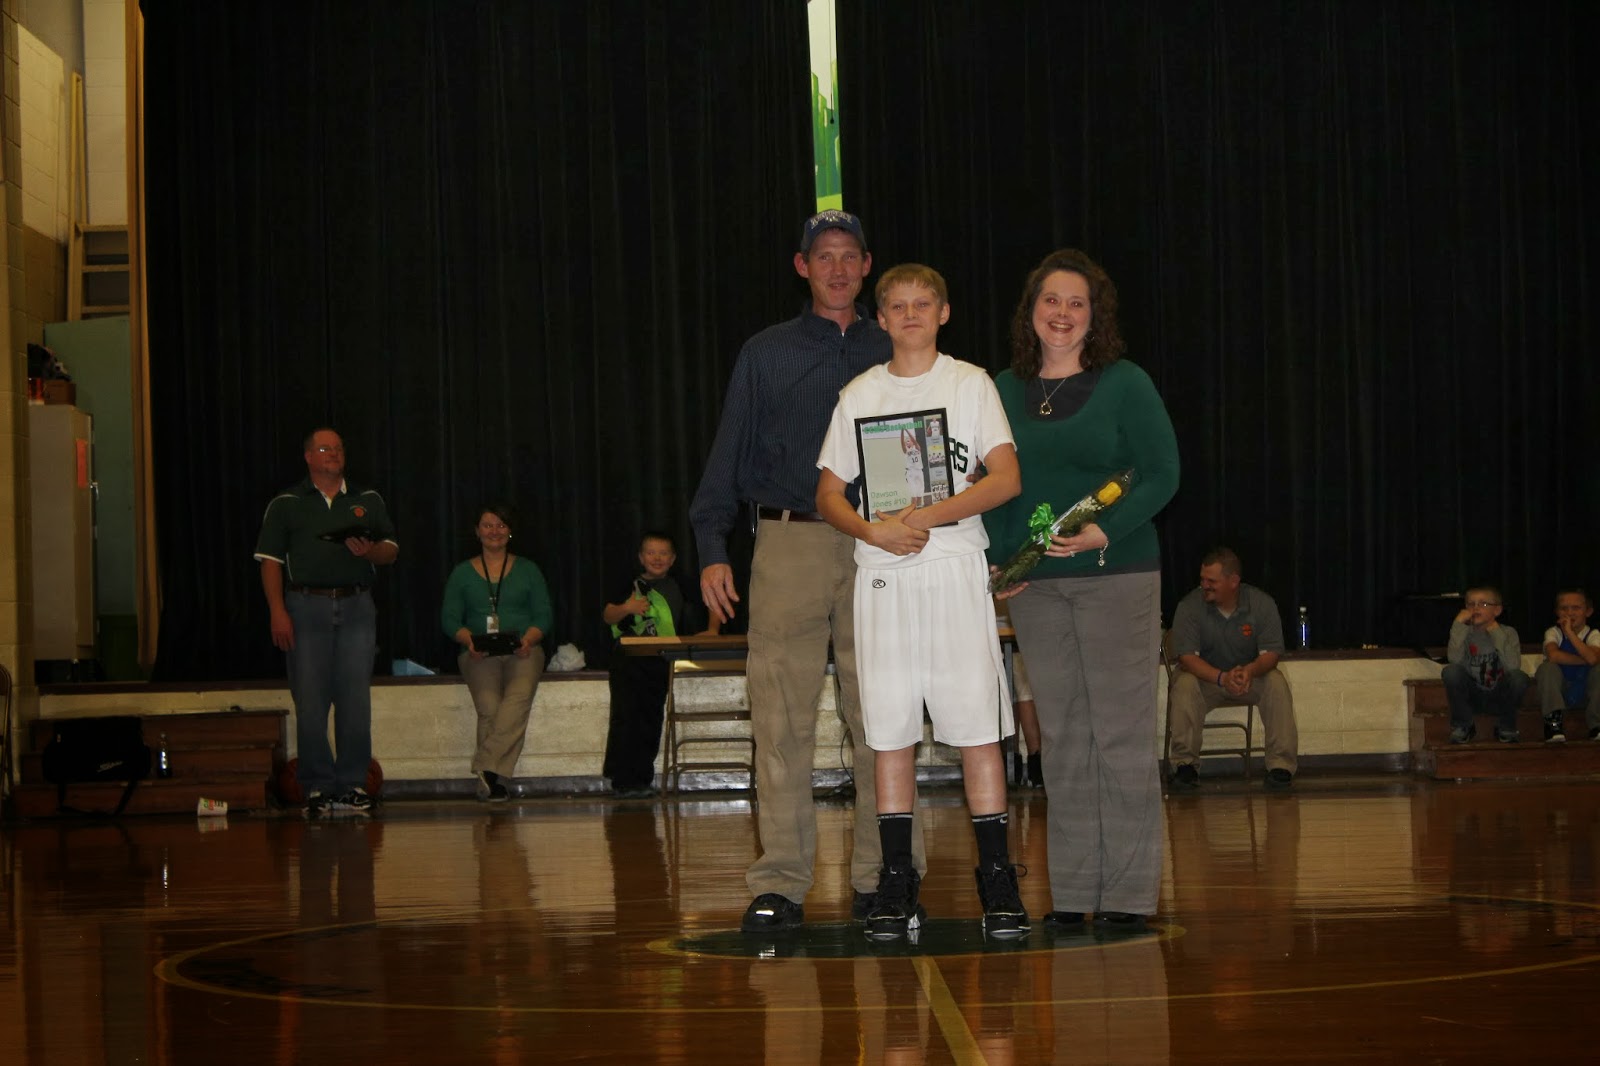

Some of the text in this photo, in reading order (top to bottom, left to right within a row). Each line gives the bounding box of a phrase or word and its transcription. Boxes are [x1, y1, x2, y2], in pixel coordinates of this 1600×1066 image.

[871, 490, 898, 498] Dawson
[872, 497, 907, 508] Jones #10
